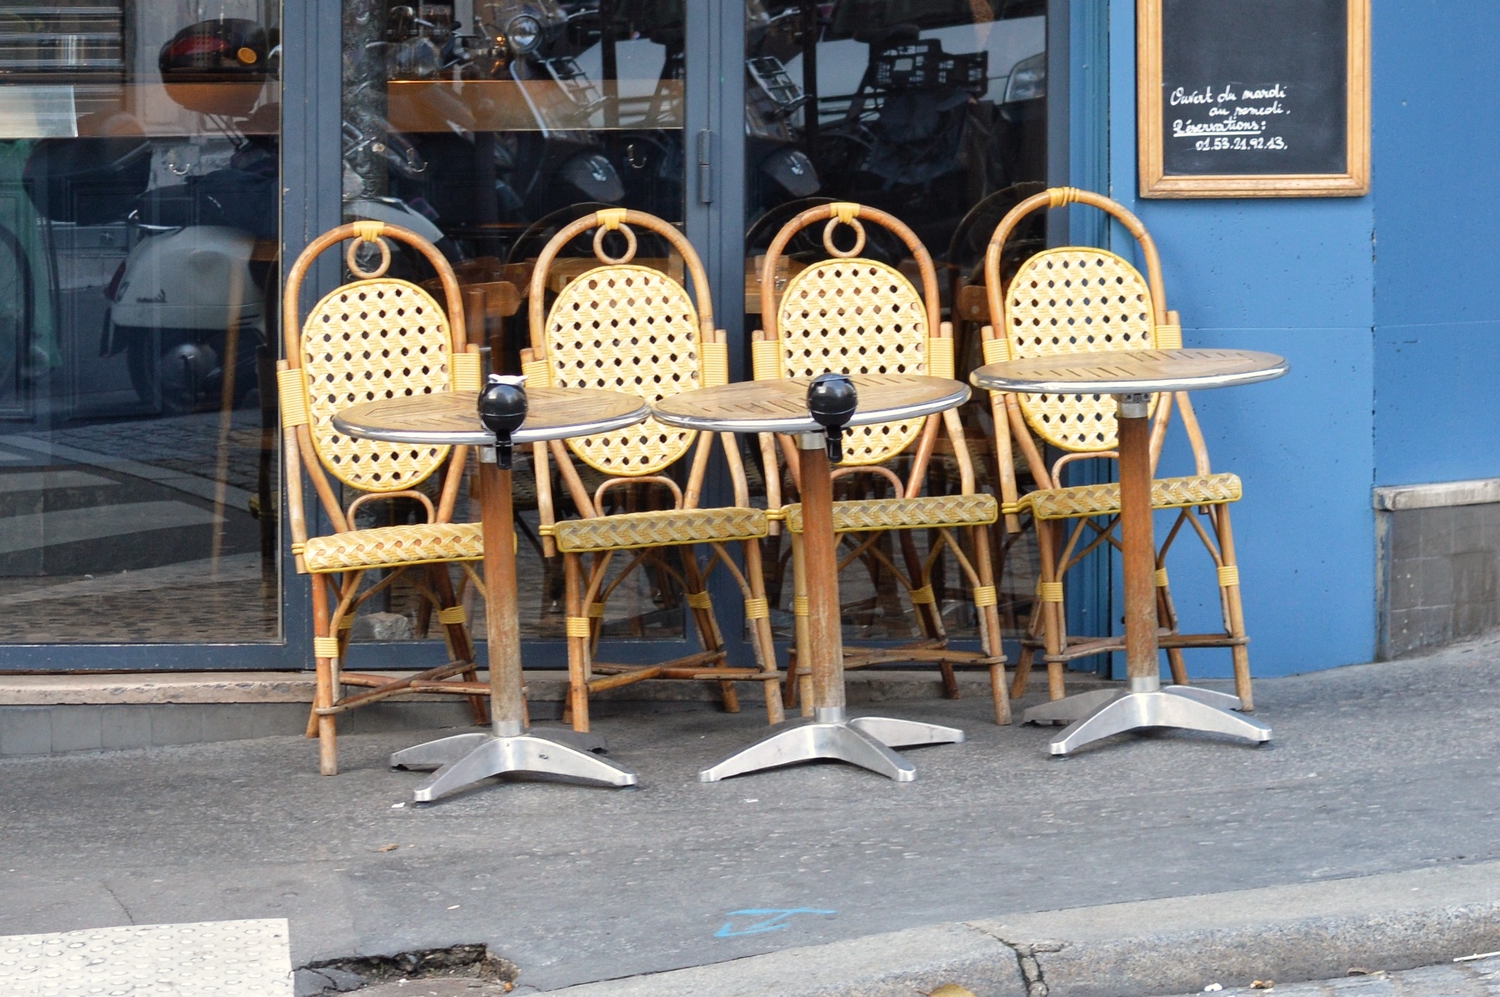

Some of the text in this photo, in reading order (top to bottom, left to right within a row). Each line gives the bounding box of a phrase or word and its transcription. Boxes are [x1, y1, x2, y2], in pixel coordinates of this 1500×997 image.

[1217, 84, 1237, 102] du
[1242, 83, 1287, 100] mardi
[1209, 107, 1230, 116] au
